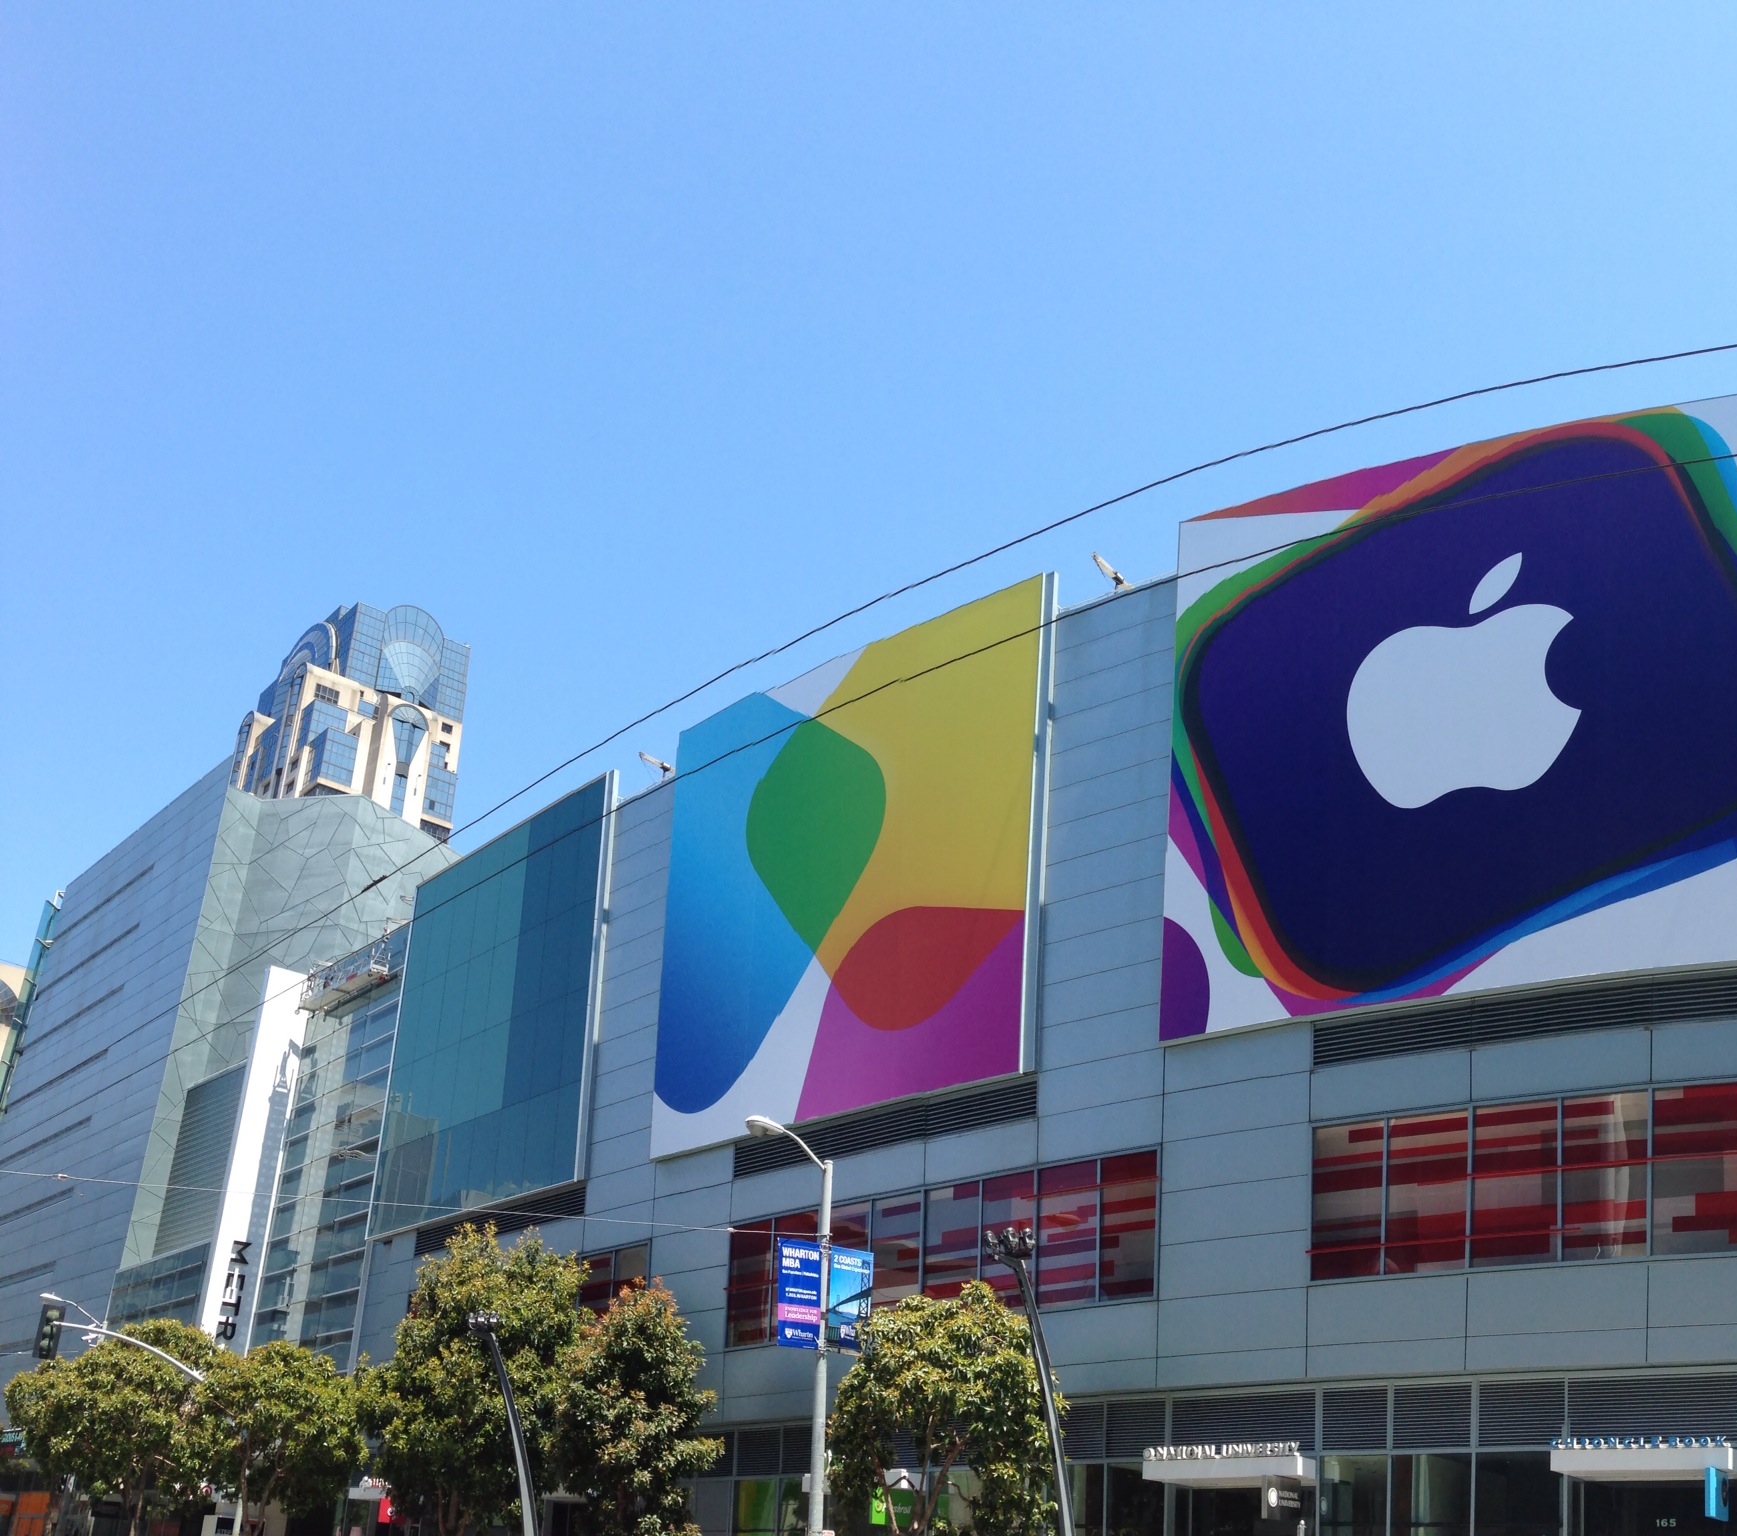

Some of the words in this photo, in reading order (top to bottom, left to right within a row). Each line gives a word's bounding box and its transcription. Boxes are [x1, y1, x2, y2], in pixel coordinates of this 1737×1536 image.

[782, 1247, 819, 1261] WHARTON
[834, 1254, 839, 1263] 2
[839, 1255, 862, 1267] COASTS
[782, 1257, 801, 1269] MBA
[215, 1240, 252, 1341] METR
[785, 1311, 817, 1322] Leadership
[1222, 1441, 1300, 1457] UNIVERSITY
[1656, 1518, 1677, 1528] 165
